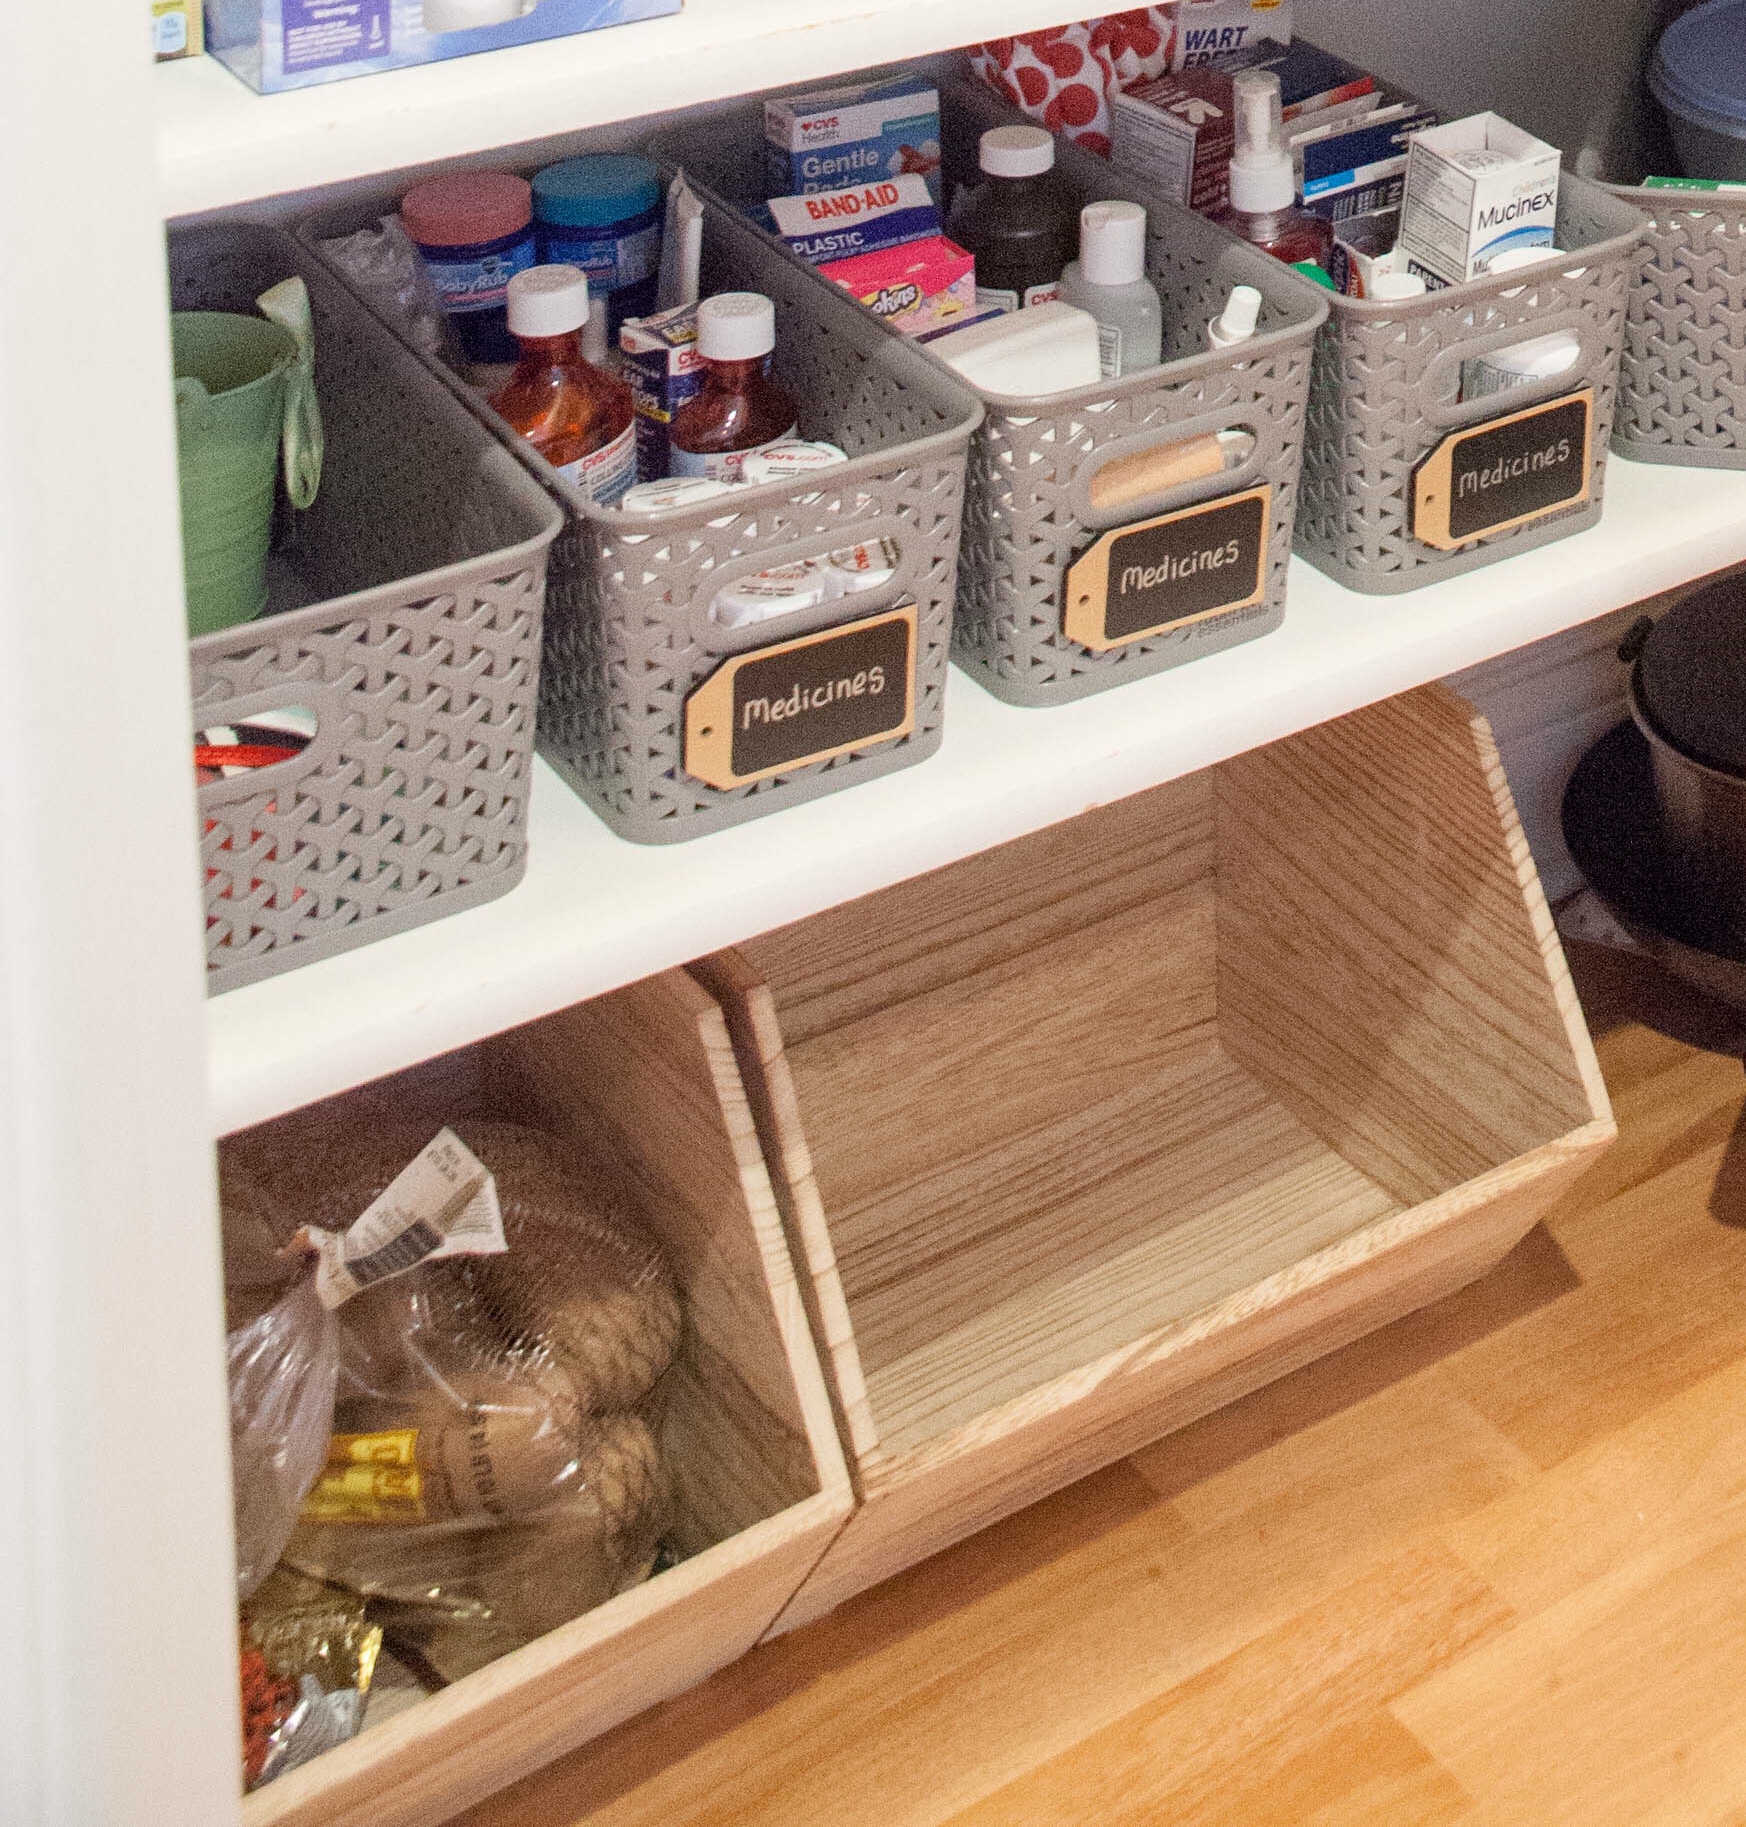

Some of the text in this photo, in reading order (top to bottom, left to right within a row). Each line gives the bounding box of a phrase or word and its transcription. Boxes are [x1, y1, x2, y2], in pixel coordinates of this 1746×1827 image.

[1184, 26, 1249, 52] WART
[802, 128, 841, 144] Health
[813, 115, 840, 131] CVS
[802, 150, 880, 181] Gentle
[1477, 191, 1556, 232] Mucinex
[793, 231, 865, 258] PLASTIC
